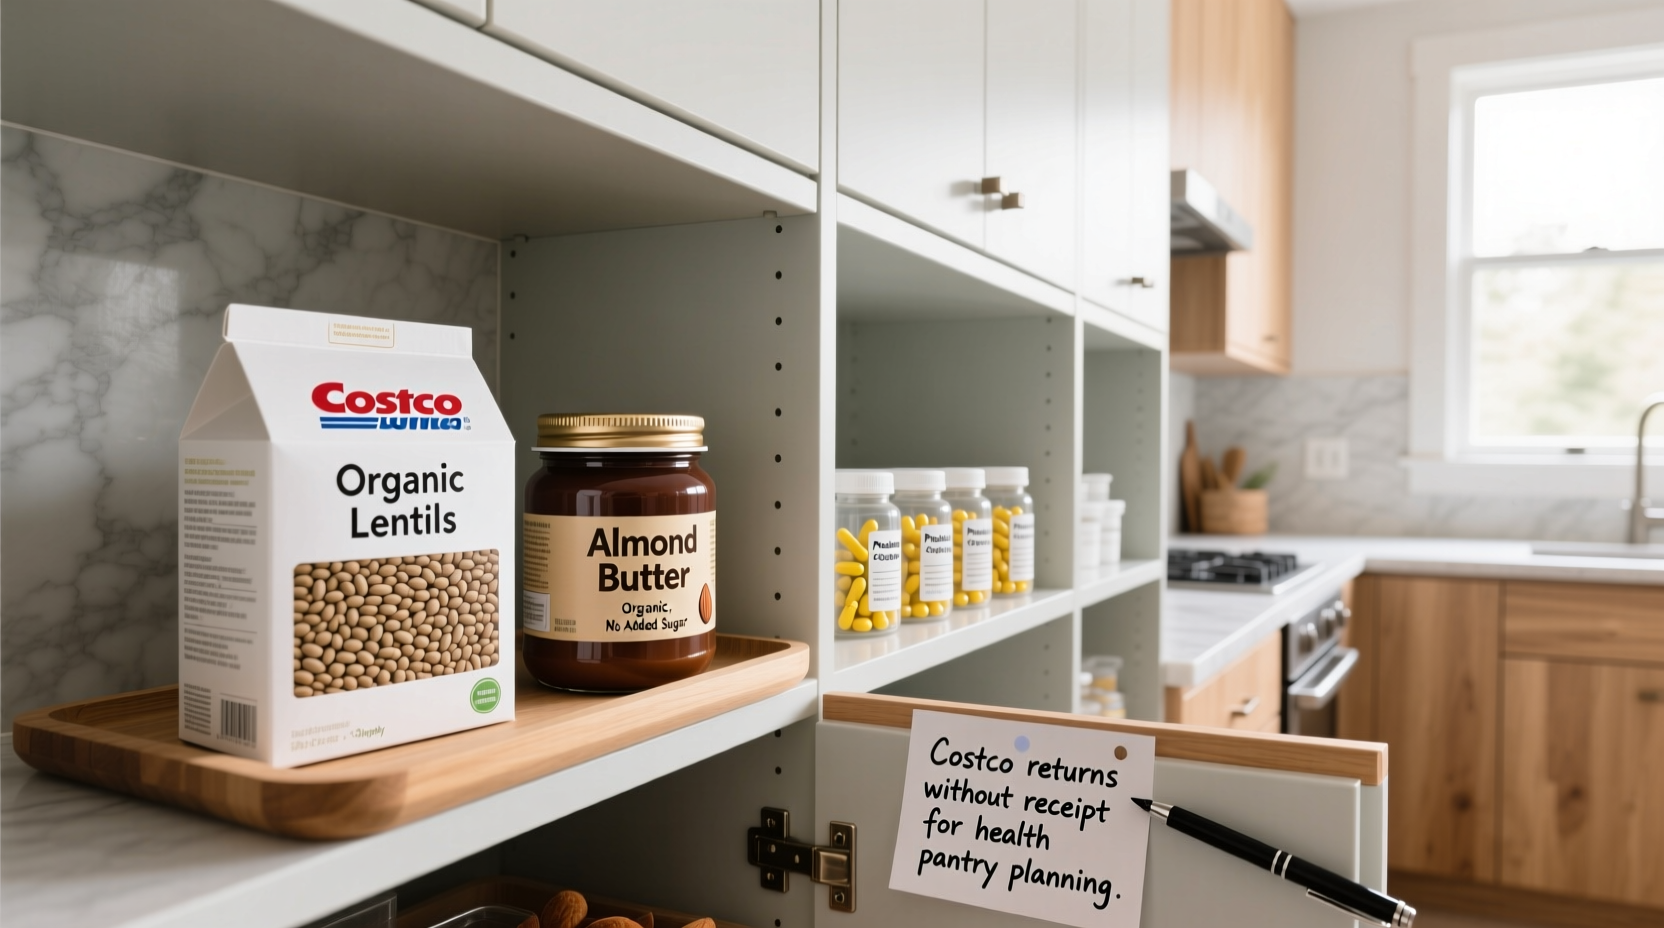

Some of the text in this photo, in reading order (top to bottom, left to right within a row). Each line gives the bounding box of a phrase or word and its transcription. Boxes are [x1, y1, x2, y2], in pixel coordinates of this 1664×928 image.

[311, 382, 463, 416] Costco
[336, 462, 465, 504] Organic
[350, 502, 458, 539] Lentils
[586, 524, 698, 558] Almond
[598, 563, 691, 592] Butter
[606, 619, 621, 632] No
[621, 600, 673, 618] Organic,
[929, 736, 1119, 788] Costco returns
[924, 777, 1111, 832] without receipt
[922, 806, 1051, 851] for health
[917, 848, 1122, 911] pantry planning.
